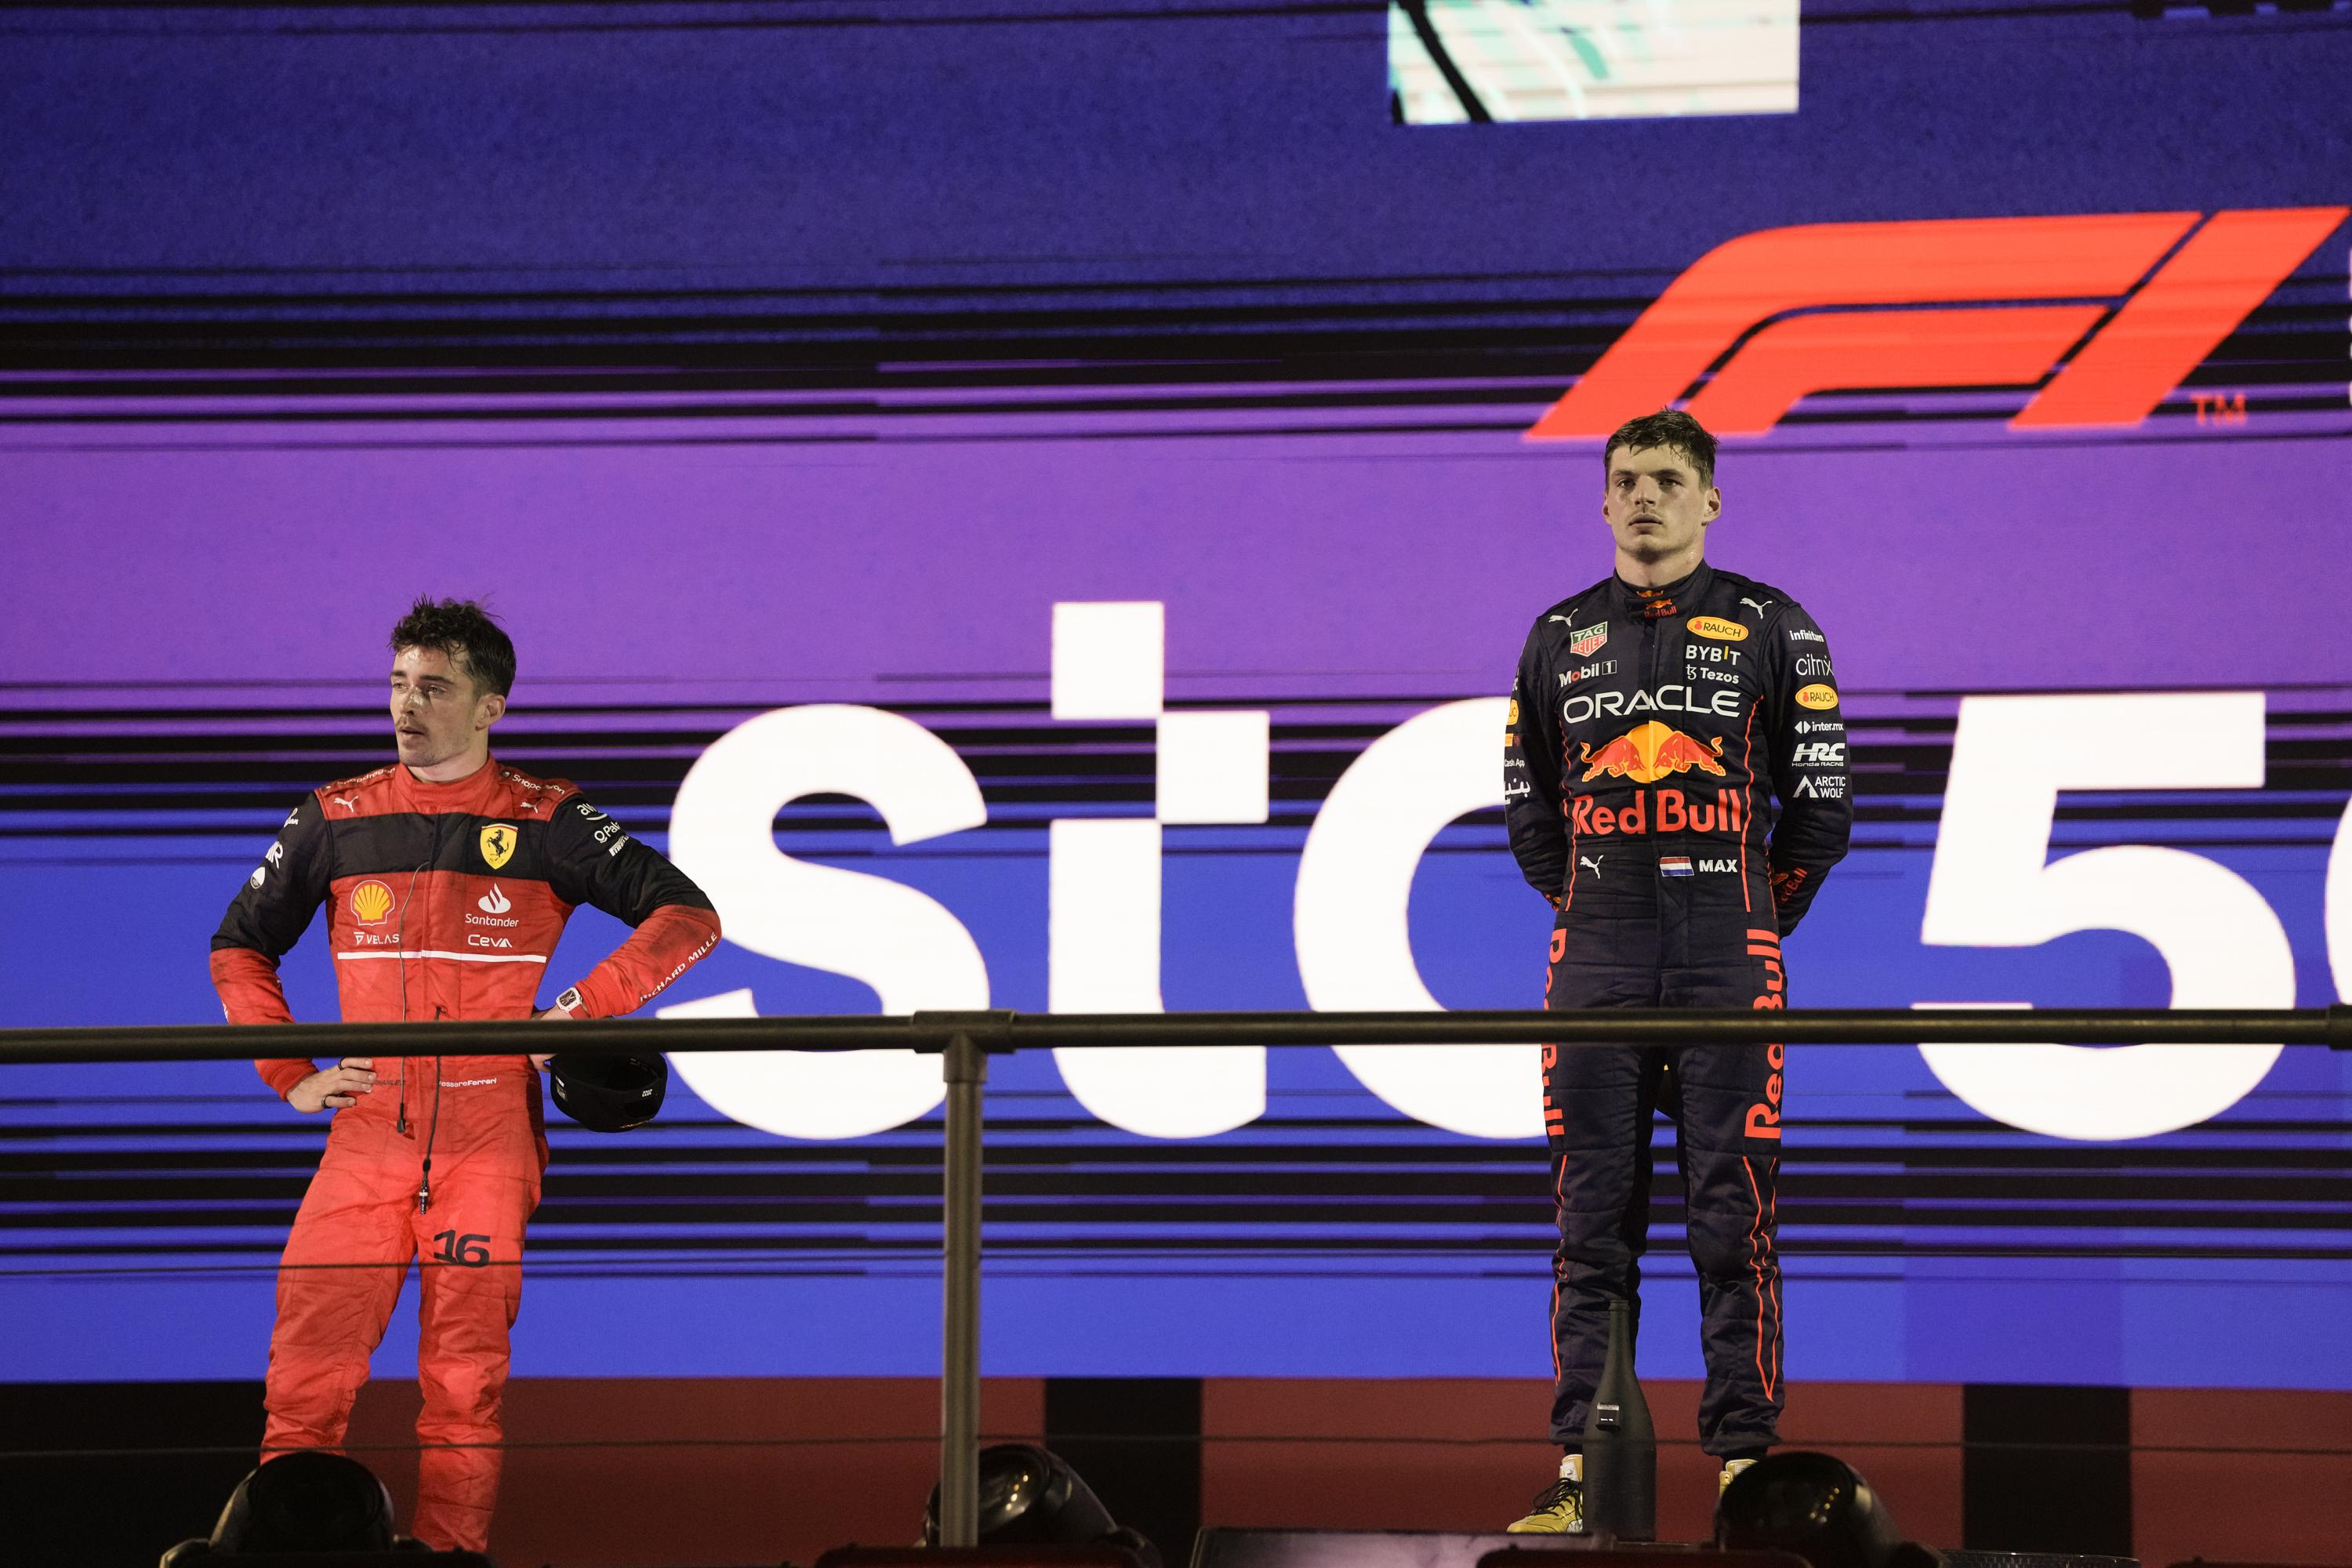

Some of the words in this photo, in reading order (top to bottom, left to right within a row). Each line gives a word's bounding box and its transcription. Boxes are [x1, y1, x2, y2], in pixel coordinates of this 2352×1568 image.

[2190, 394, 2248, 426] TM
[1573, 625, 1605, 640] TAG
[1703, 622, 1741, 637] RAUCH
[1789, 630, 1824, 642] infinitum
[1572, 633, 1605, 655] HEUER
[1686, 644, 1741, 666] BYBIT
[1795, 653, 1835, 676] citrix
[1559, 662, 1599, 688] Mobil
[1700, 667, 1740, 684] Tezos
[1563, 684, 1742, 724] ORACLE
[1810, 691, 1835, 702] RAUCH
[1811, 721, 1844, 731] inter.mx
[1792, 742, 1846, 761] HRC
[1815, 776, 1846, 786] ARCTIC
[1820, 788, 1844, 798] WOLF
[1571, 789, 1646, 835] Red
[1656, 789, 1741, 832] Bull
[1699, 859, 1737, 873] MAX
[465, 913, 519, 927] Santander
[1910, 691, 2352, 1141] 5
[367, 933, 400, 945] VELAS
[688, 931, 717, 964] MILLE
[1541, 1044, 1566, 1137] Bll
[434, 1229, 491, 1268] 16
